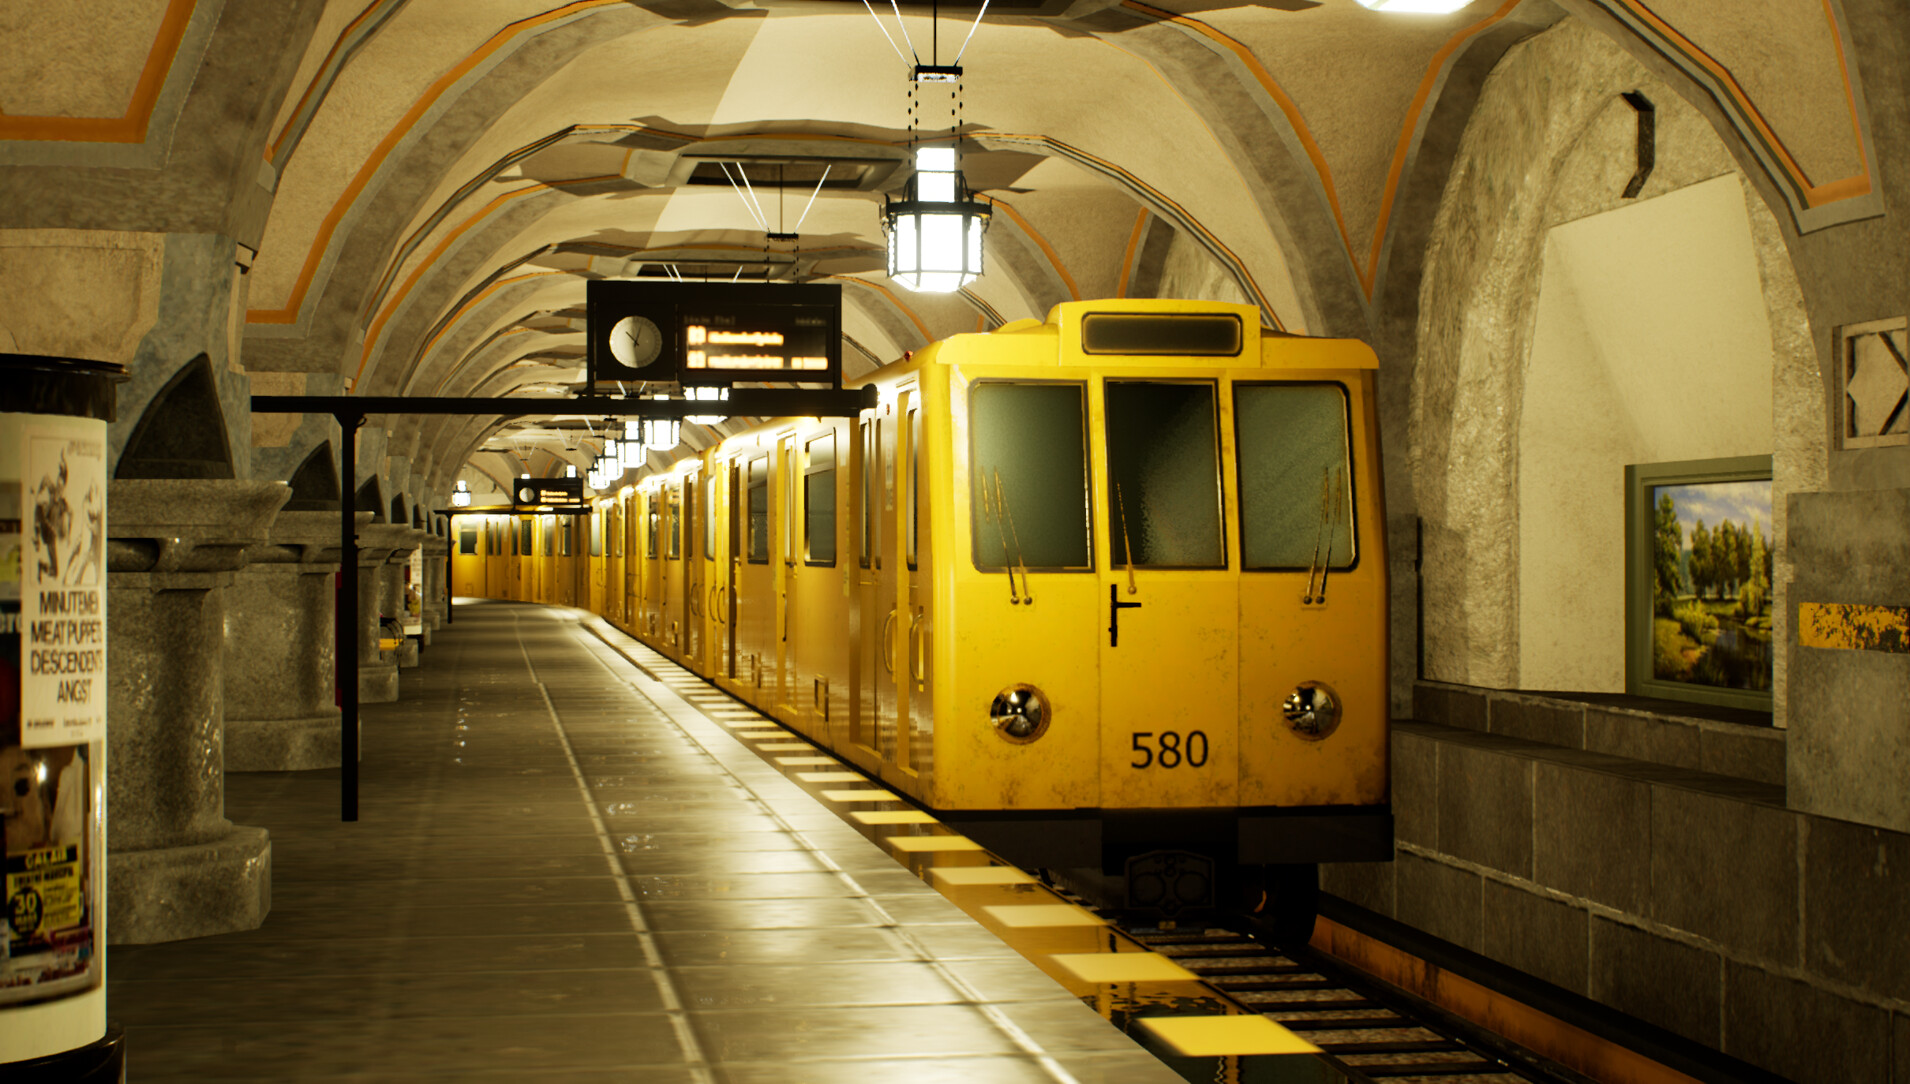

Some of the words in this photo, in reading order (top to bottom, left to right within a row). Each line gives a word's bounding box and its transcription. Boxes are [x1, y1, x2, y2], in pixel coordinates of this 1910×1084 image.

[30, 620, 66, 645] MEAT
[57, 679, 92, 704] ANGST
[1131, 730, 1209, 769] 580
[14, 892, 37, 914] 30
